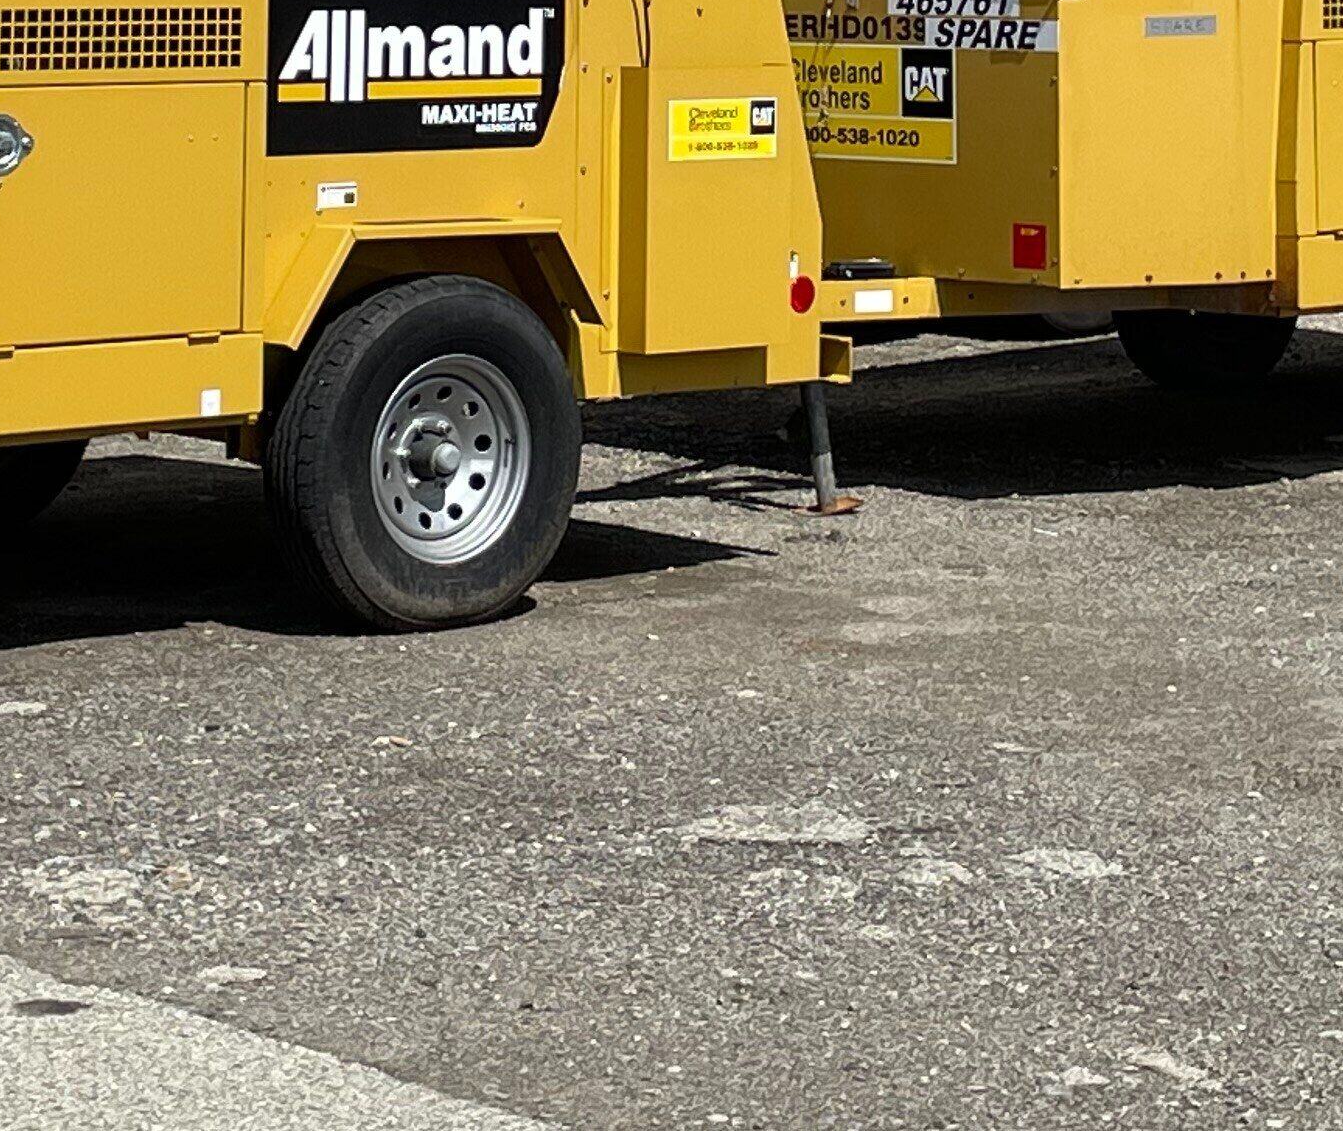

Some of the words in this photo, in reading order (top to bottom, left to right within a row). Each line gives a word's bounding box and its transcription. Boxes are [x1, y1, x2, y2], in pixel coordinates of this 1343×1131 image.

[786, 14, 926, 42] ERHD0139
[934, 19, 1041, 51] SPARE
[277, 7, 545, 103] Allmand
[797, 85, 871, 110] rohers
[905, 66, 947, 103] CAT
[421, 101, 538, 125] MAXI-HEAT
